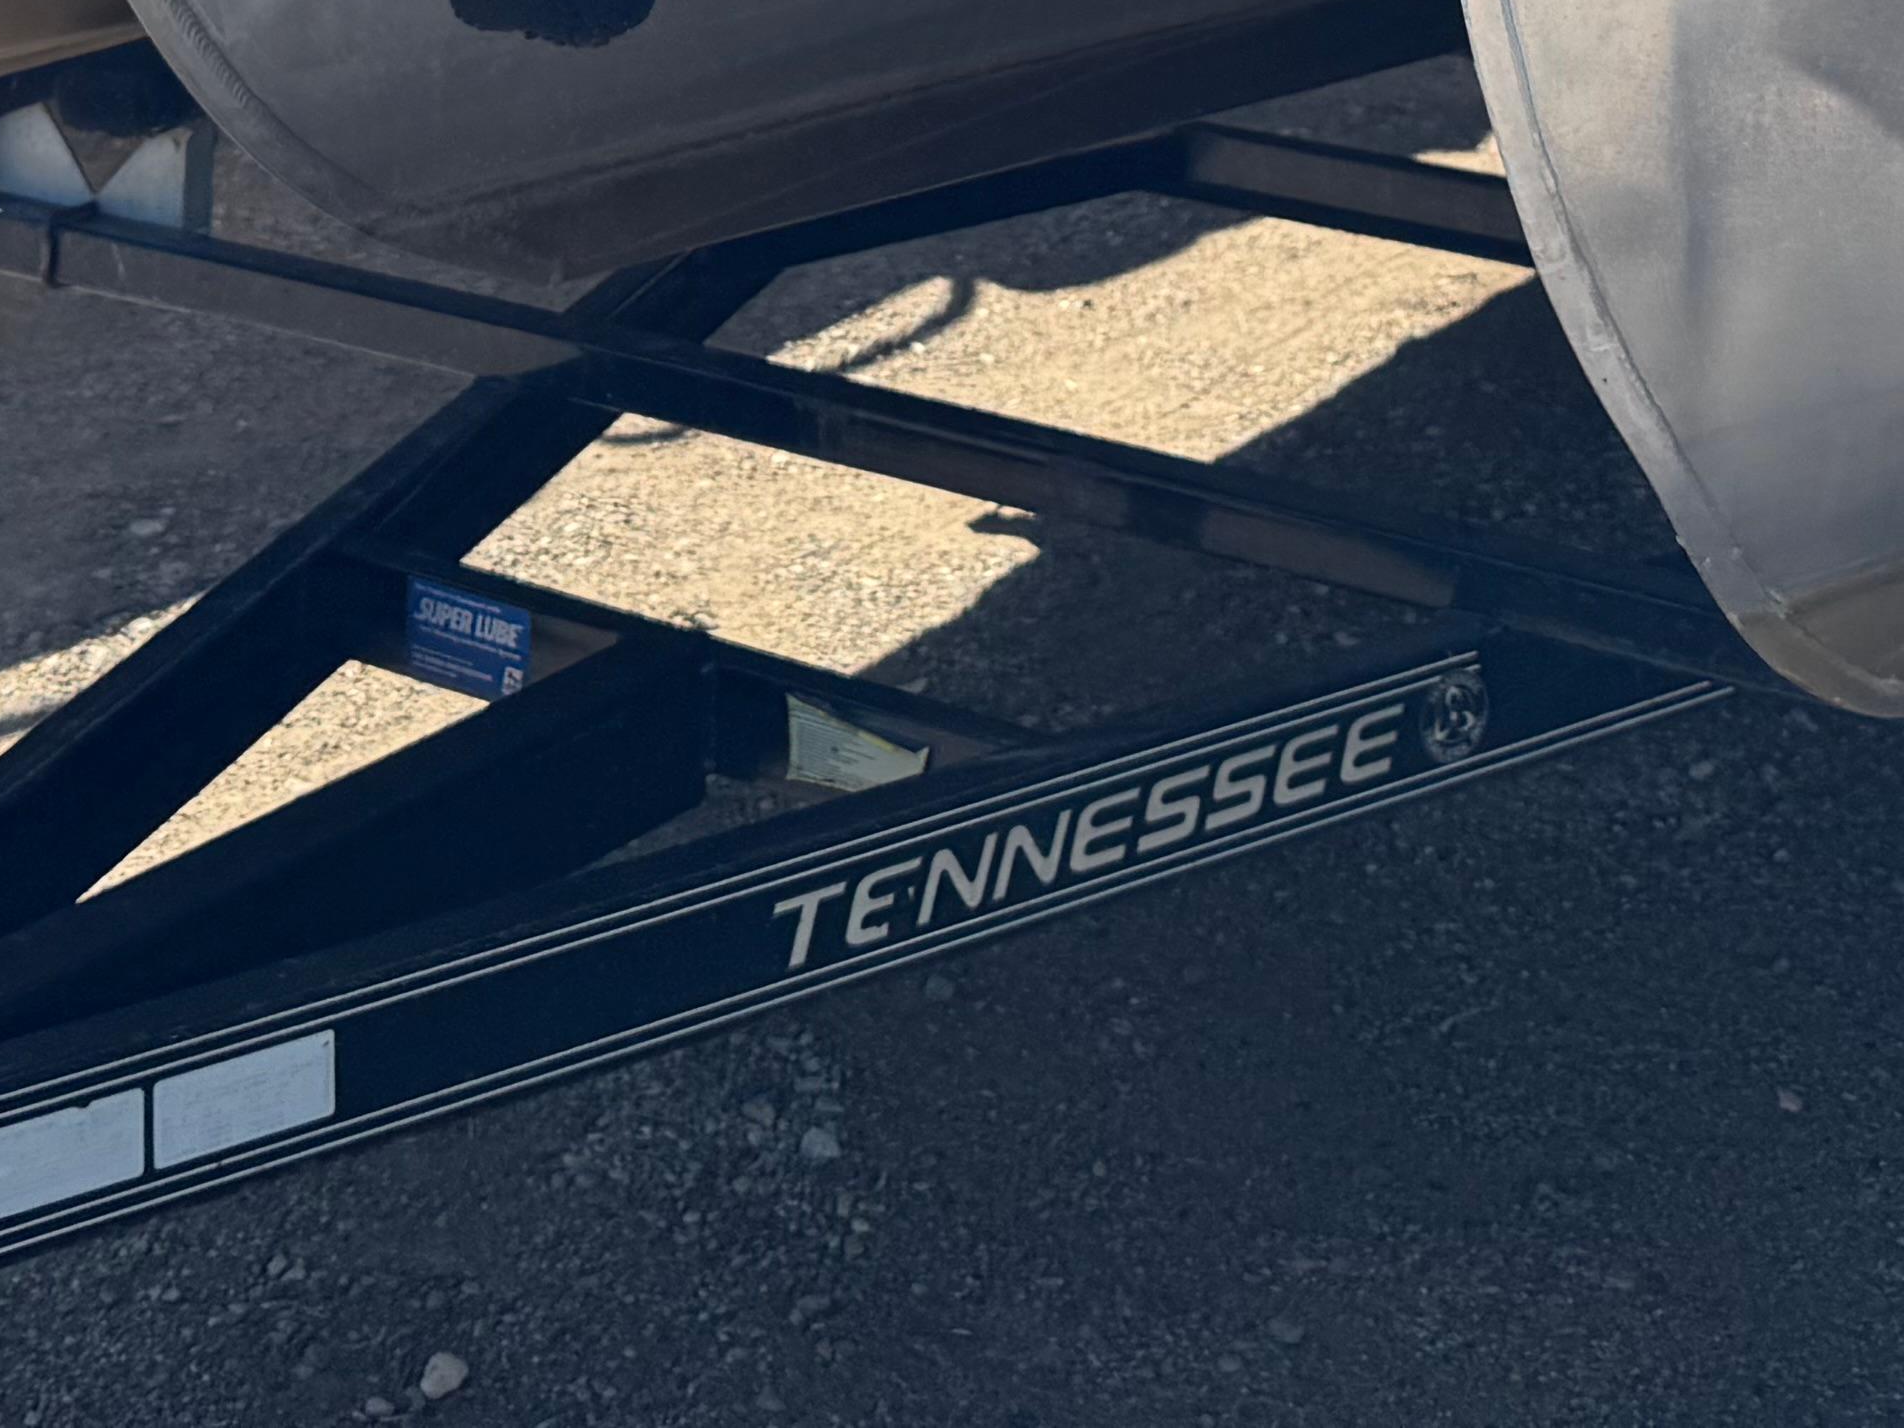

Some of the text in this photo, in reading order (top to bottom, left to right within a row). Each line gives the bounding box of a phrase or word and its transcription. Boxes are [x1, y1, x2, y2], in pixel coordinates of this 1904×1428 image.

[413, 597, 473, 635] SUPER
[474, 613, 524, 648] LUBE
[773, 703, 1405, 969] TENNESSEE
